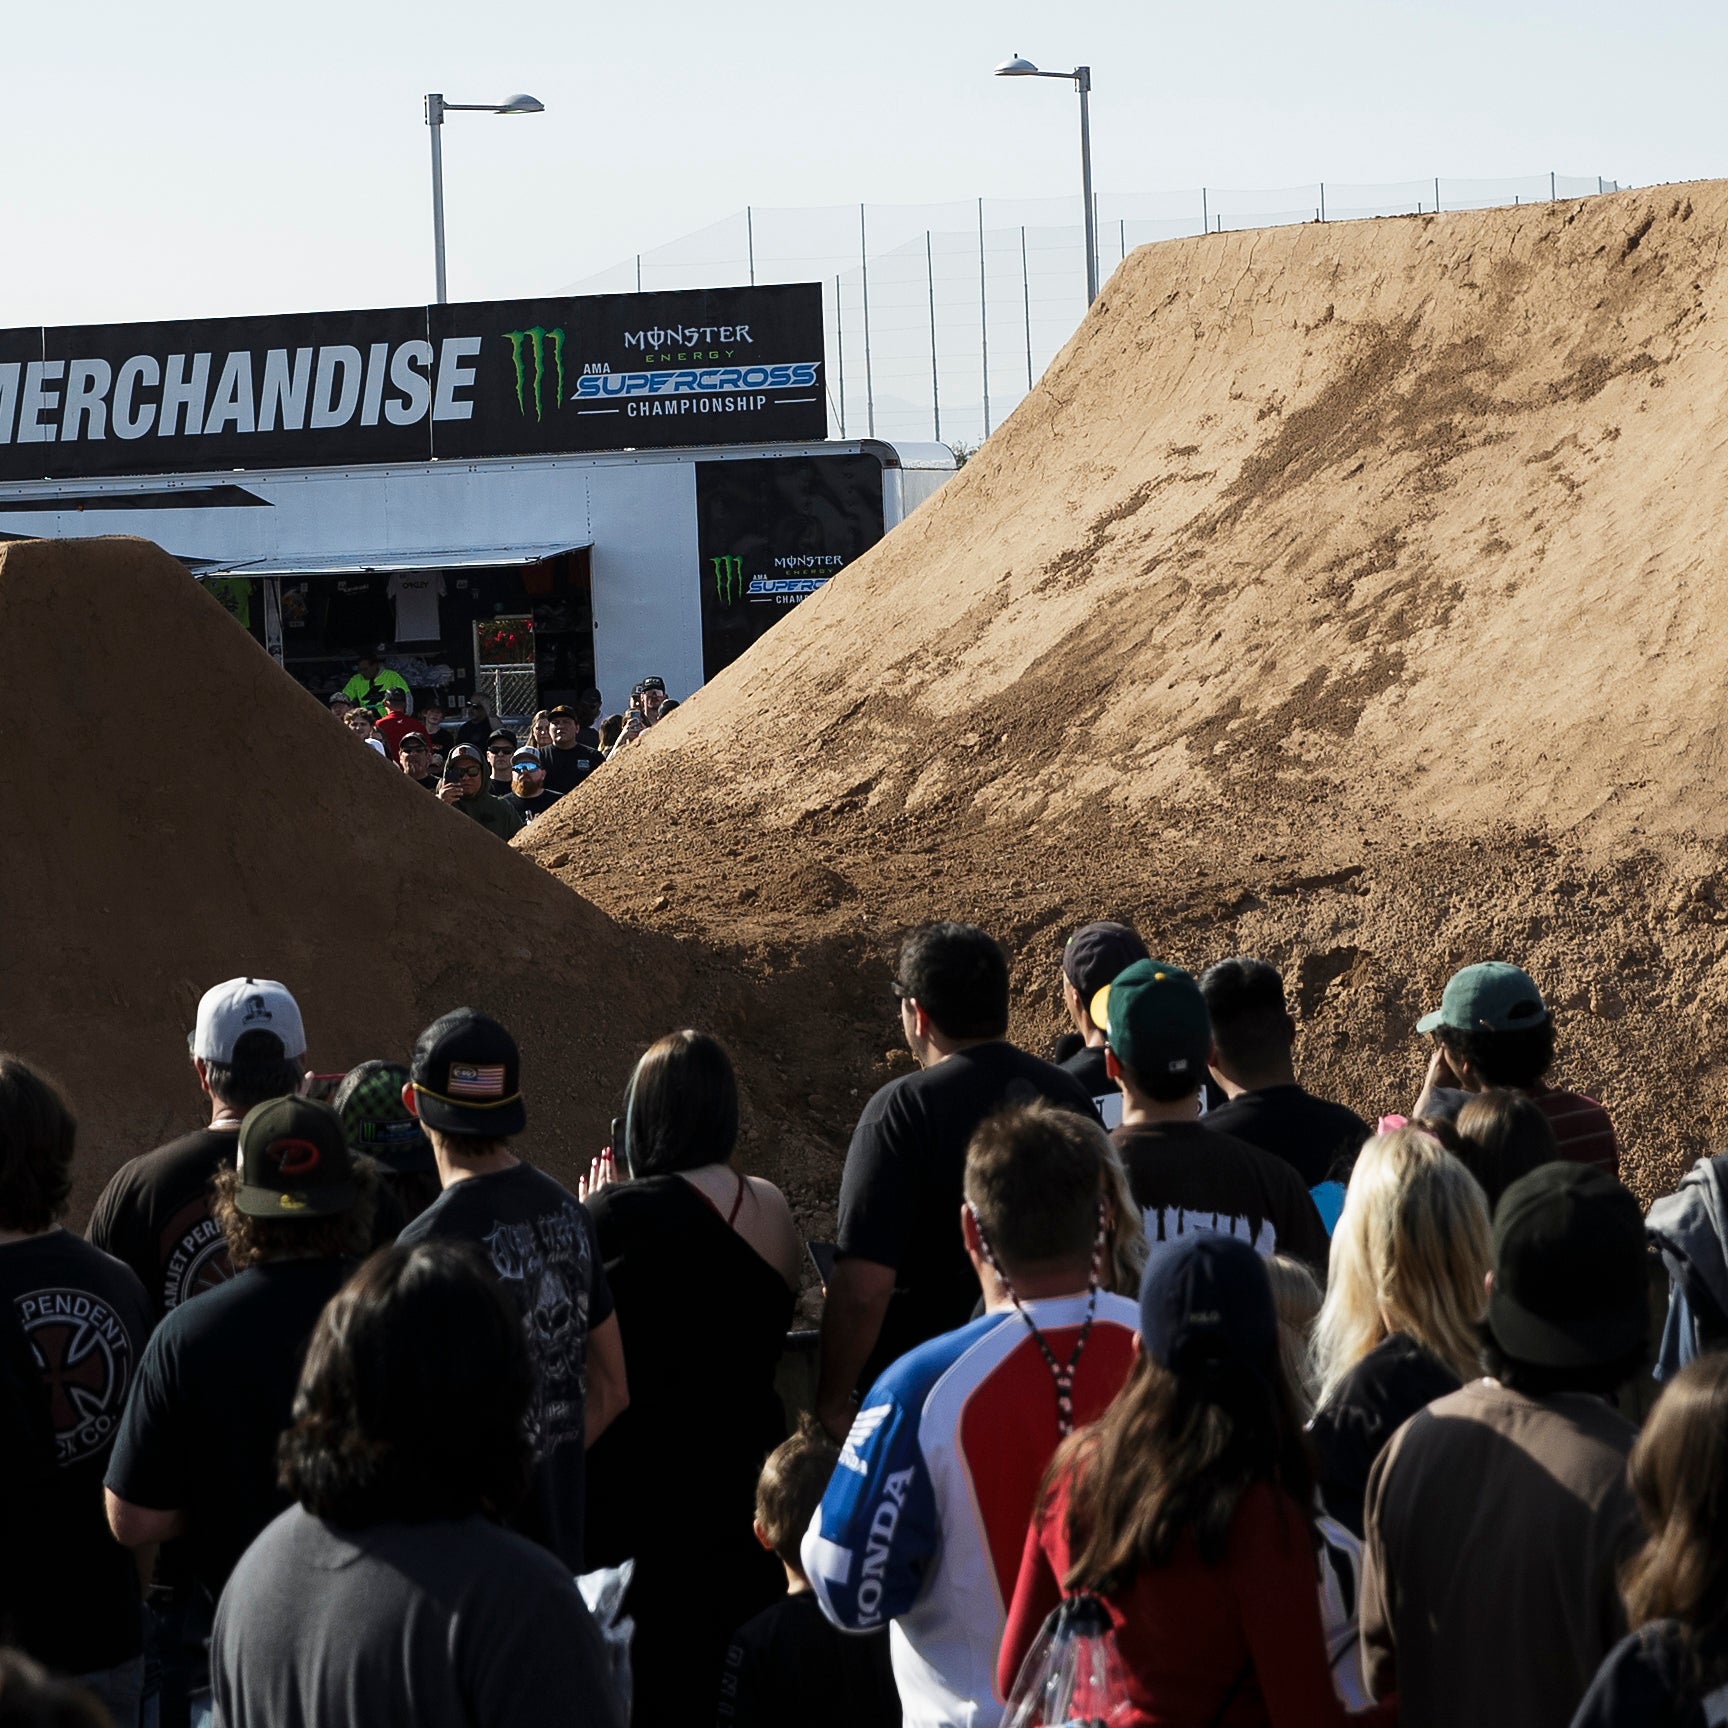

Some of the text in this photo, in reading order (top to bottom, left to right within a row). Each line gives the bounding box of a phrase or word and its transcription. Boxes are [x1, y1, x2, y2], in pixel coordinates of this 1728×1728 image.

[624, 324, 754, 351] MONSTER
[645, 350, 734, 363] ENERGY
[583, 363, 611, 374] AMA
[574, 363, 820, 398] SUPERCROSS
[627, 395, 766, 417] CHAMPIONSHIP
[774, 555, 844, 568] MONSTER
[21, 1294, 128, 1352] PENDENT
